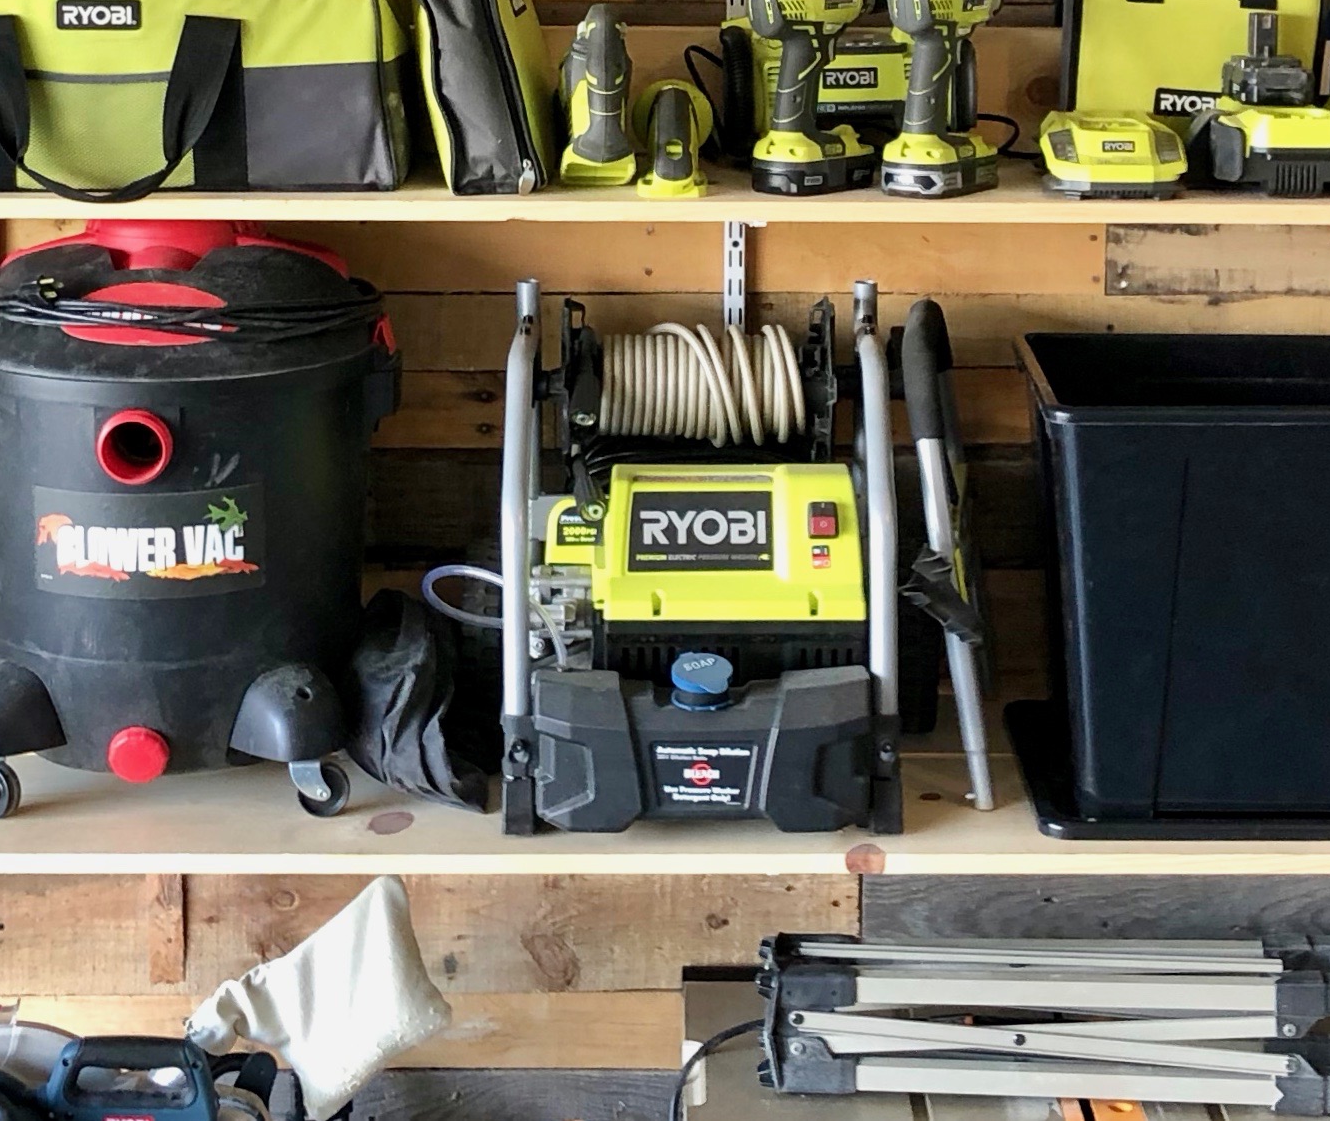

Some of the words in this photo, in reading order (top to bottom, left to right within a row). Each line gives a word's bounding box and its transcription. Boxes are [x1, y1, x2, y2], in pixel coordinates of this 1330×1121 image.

[62, 5, 133, 26] RYOBI
[825, 71, 875, 86] RYOBI
[1104, 142, 1134, 151] RYOBI
[639, 510, 767, 546] RYOBI
[56, 525, 177, 572] BLOWER
[183, 523, 245, 566] VAC
[683, 657, 717, 672] SOAP
